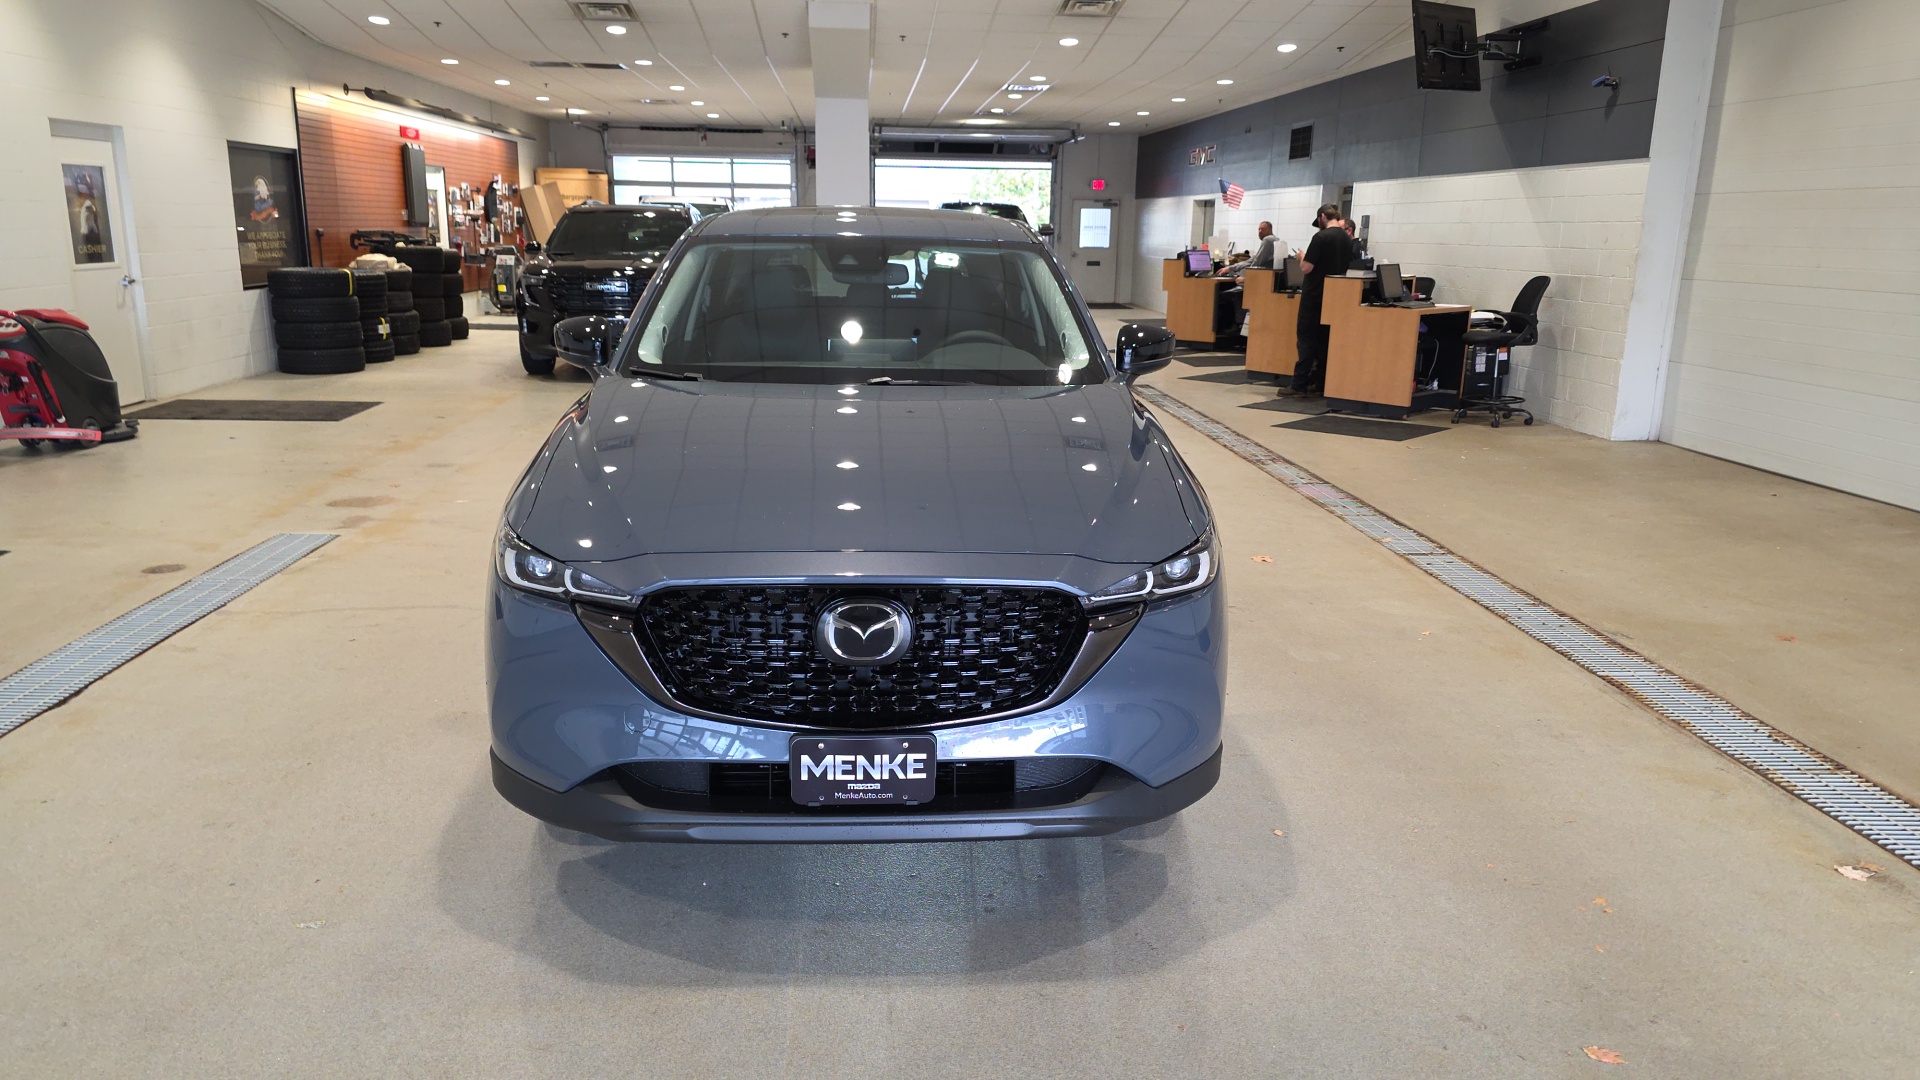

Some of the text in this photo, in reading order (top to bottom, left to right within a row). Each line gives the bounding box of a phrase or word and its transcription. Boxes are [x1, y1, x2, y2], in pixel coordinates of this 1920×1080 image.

[1189, 144, 1216, 167] GMC
[247, 231, 286, 240] WE APPRECIATE
[78, 244, 106, 254] CASHIER
[248, 241, 262, 249] YOUR
[800, 753, 927, 781] MENKE
[834, 791, 894, 800] MenkeAuto.com
